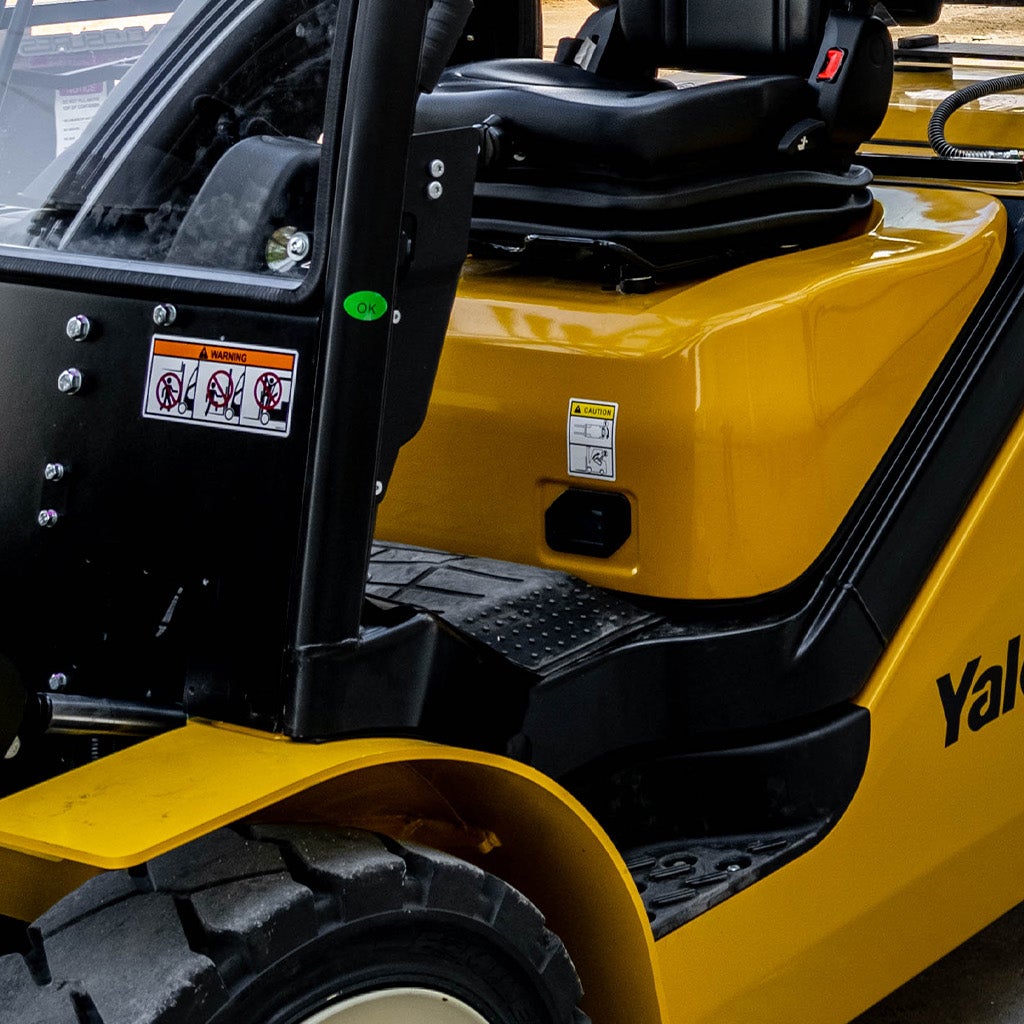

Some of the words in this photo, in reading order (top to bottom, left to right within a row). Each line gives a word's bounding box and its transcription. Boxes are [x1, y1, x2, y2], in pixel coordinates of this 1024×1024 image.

[357, 302, 377, 315] OK
[210, 349, 247, 363] WARNING
[583, 406, 612, 417] CAUTION
